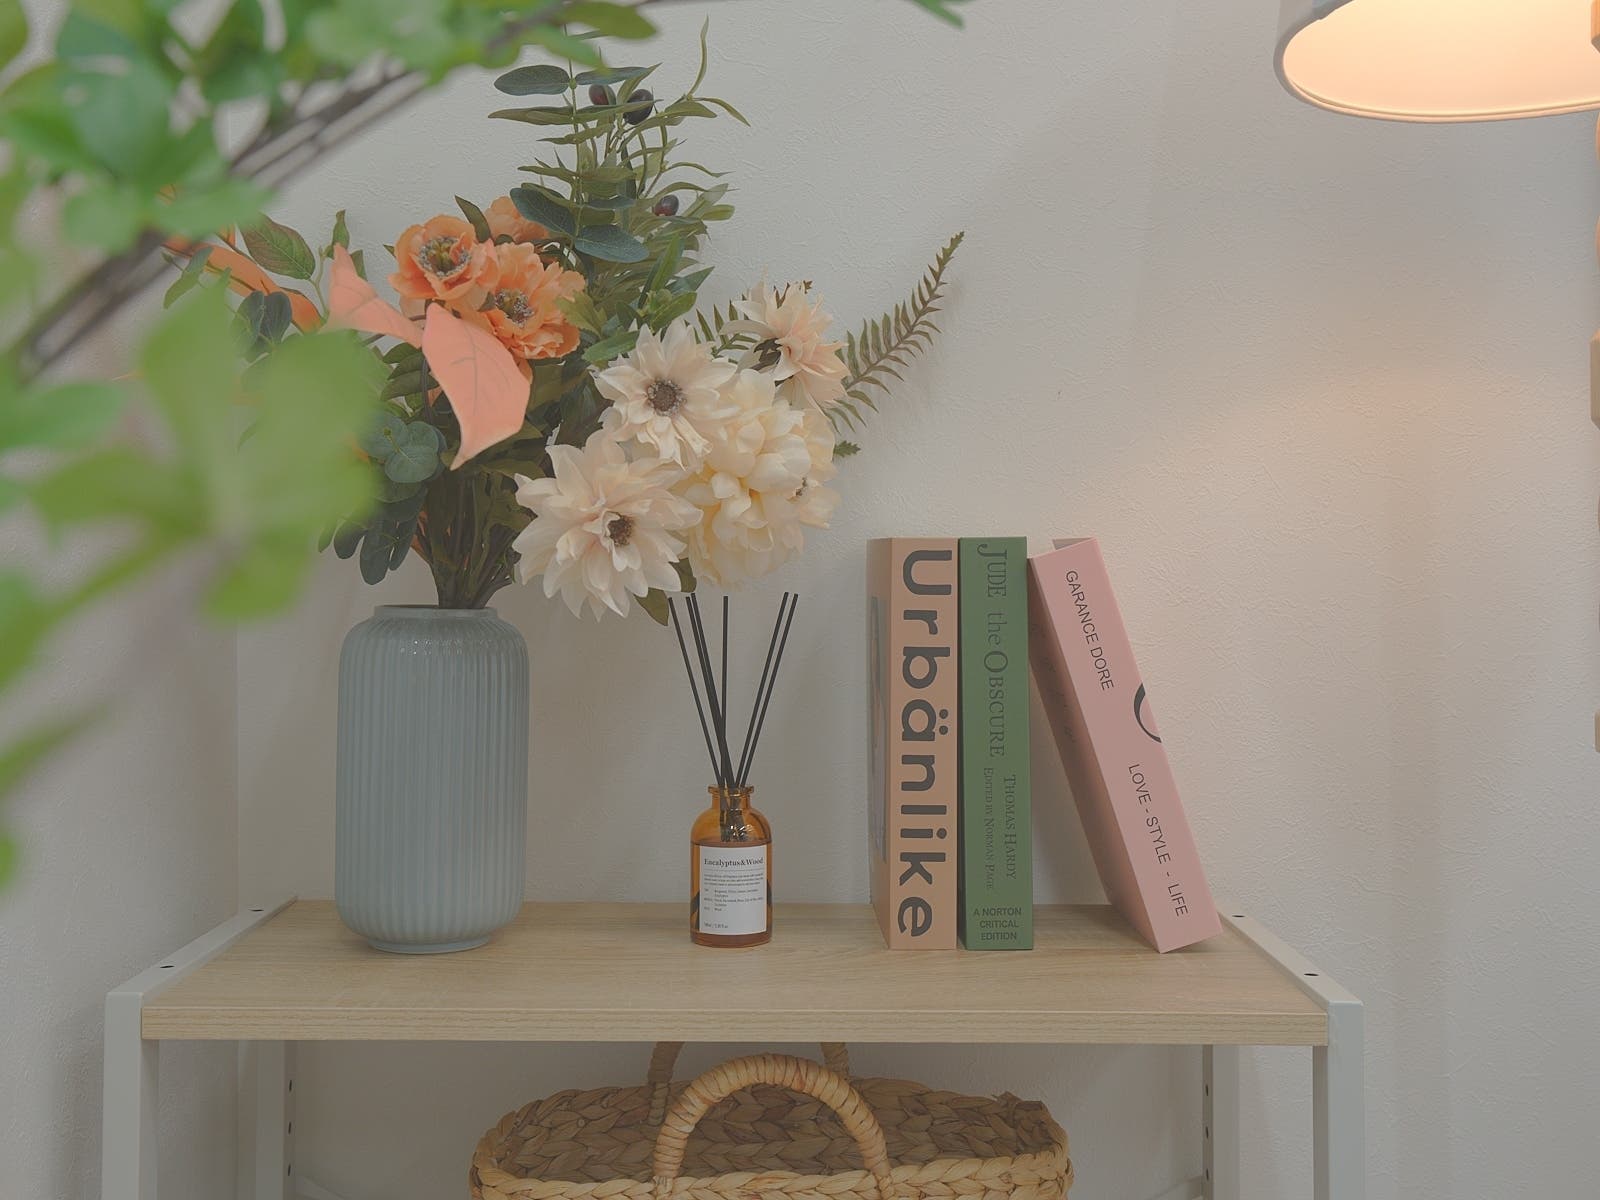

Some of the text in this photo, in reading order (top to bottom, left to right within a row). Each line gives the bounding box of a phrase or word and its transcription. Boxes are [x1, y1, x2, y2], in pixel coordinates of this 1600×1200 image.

[977, 543, 1009, 758] JUDE the OBSCURE
[1065, 570, 1115, 691] GARANCE DORE
[898, 550, 953, 937] Urbänlike
[984, 768, 995, 890] EDITED BY NORMAN PAGE
[1003, 774, 1017, 880] THOMAS HARDY
[1128, 764, 1152, 805] LOVE
[1146, 816, 1172, 865] STYLE
[1167, 883, 1189, 917] LIFE
[974, 907, 1022, 917] A NORTON
[979, 920, 1019, 929] CRITICAL
[981, 931, 1018, 941] EDITION
